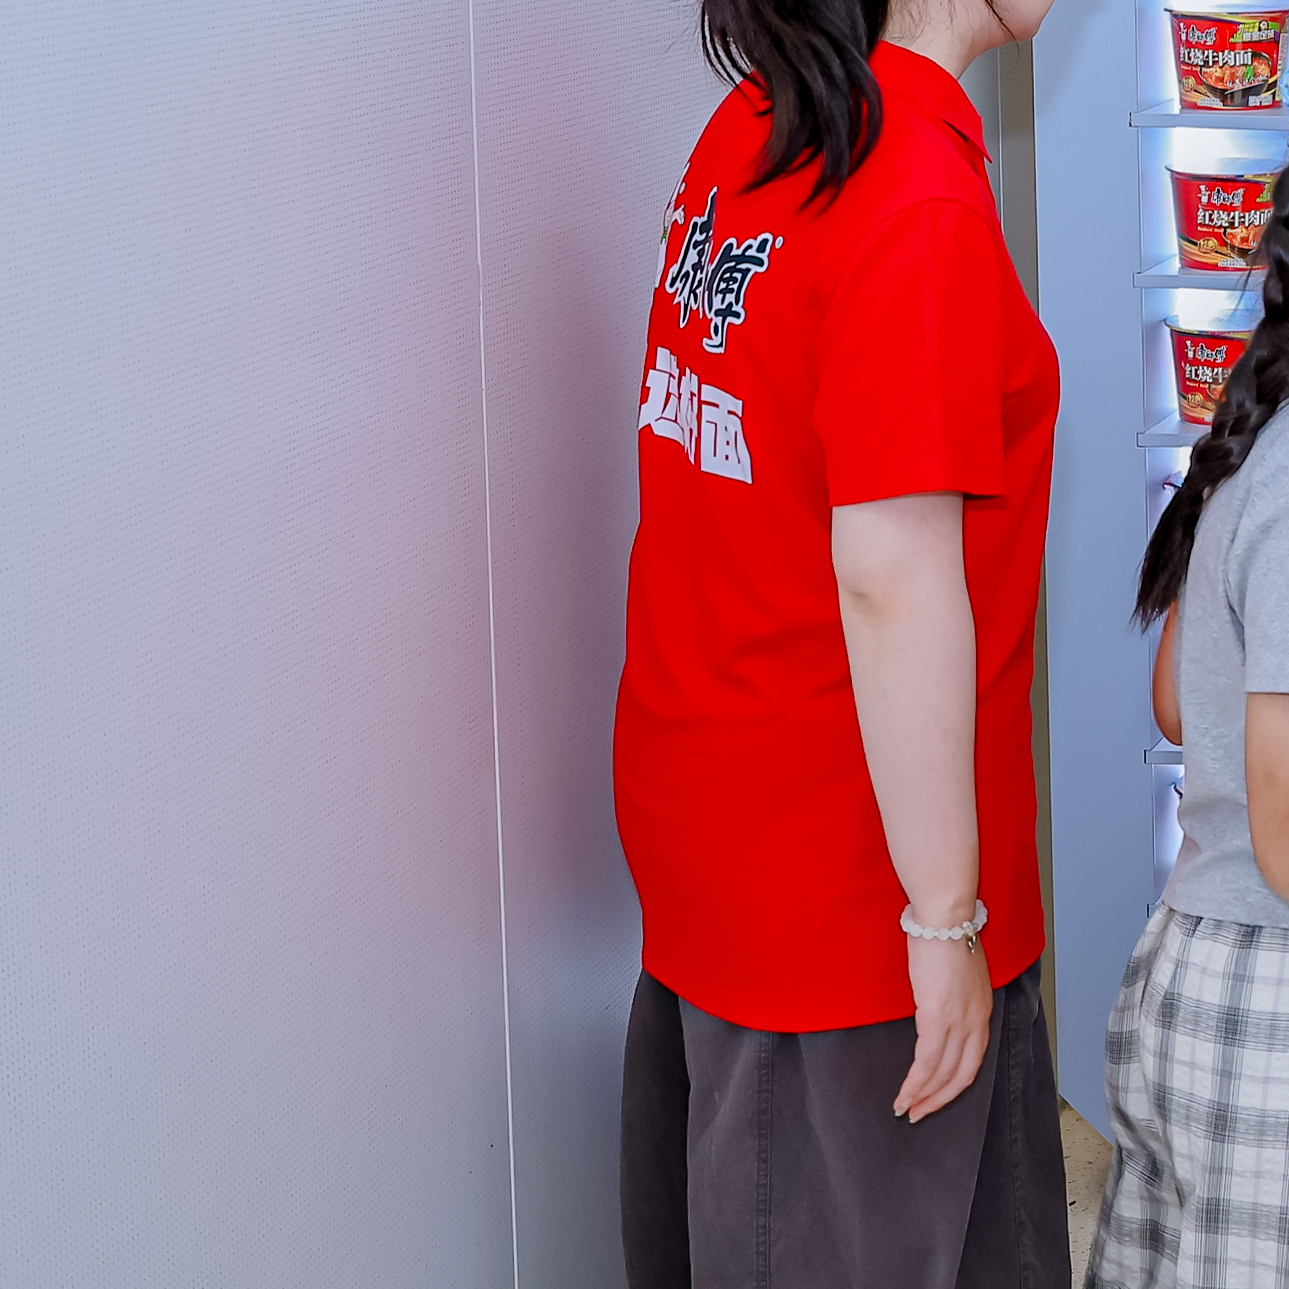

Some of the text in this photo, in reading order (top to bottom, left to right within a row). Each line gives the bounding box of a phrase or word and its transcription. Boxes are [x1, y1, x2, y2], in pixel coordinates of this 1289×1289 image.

[1180, 47, 1252, 67] 红烧牛肉面
[666, 186, 773, 353] 康傅
[1185, 365, 1230, 383] 红烧牛
